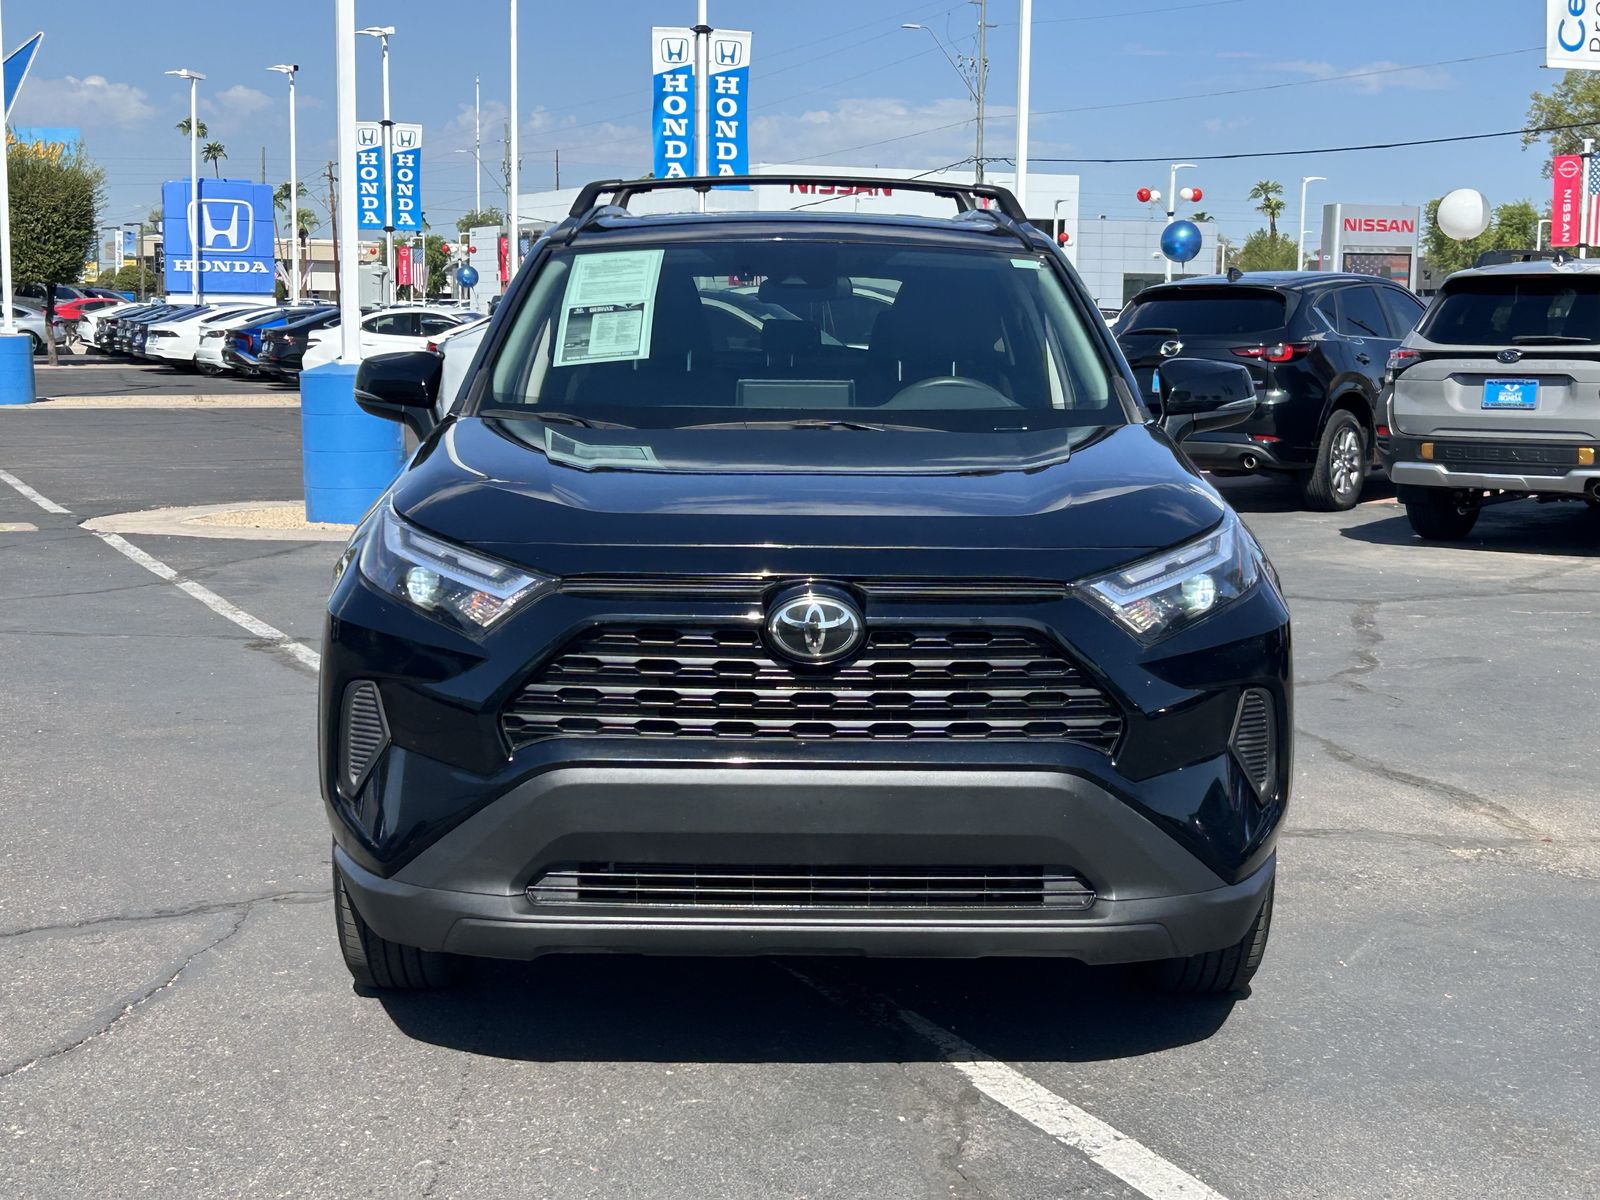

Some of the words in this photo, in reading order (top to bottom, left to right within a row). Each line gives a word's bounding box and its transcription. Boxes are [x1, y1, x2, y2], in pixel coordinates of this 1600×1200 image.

[662, 74, 689, 179] HONDA
[715, 76, 740, 177] HONDA
[358, 152, 381, 224] HONDA
[396, 154, 416, 226] HONDA
[1562, 188, 1572, 242] NISSAN
[1343, 218, 1414, 233] NISSAN
[173, 259, 270, 273] HONDA
